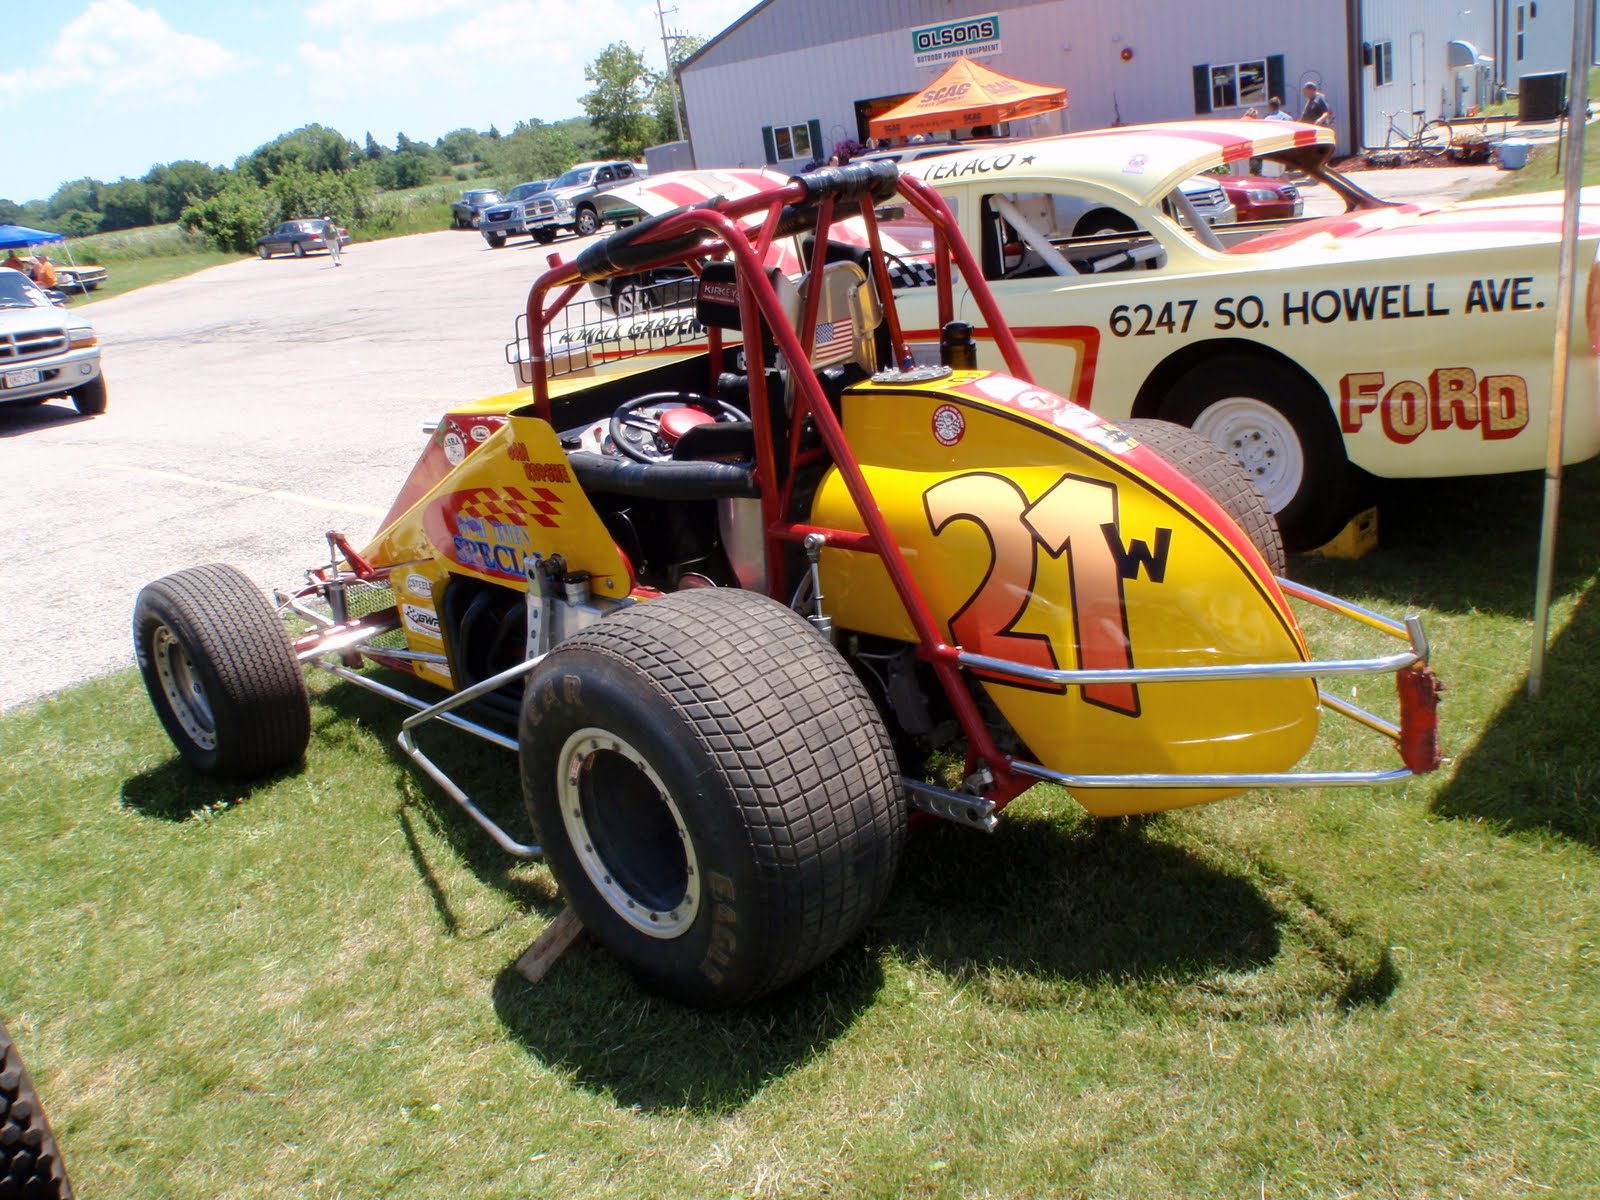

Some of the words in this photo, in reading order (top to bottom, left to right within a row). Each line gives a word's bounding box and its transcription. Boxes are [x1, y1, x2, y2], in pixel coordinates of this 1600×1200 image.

[917, 20, 995, 49] OLSONS
[917, 53, 943, 64] OUTDOOR
[943, 49, 964, 59] POWER
[965, 43, 999, 56] EQUIPMENT
[920, 82, 972, 104] SCAG
[924, 153, 1016, 181] TEXACO
[704, 285, 738, 298] KIRKEY
[1109, 300, 1198, 337] 6247
[1214, 295, 1270, 330] SO.
[1283, 282, 1450, 326] HOWELL
[1465, 276, 1546, 314] AVE.
[1340, 366, 1530, 444] FORD
